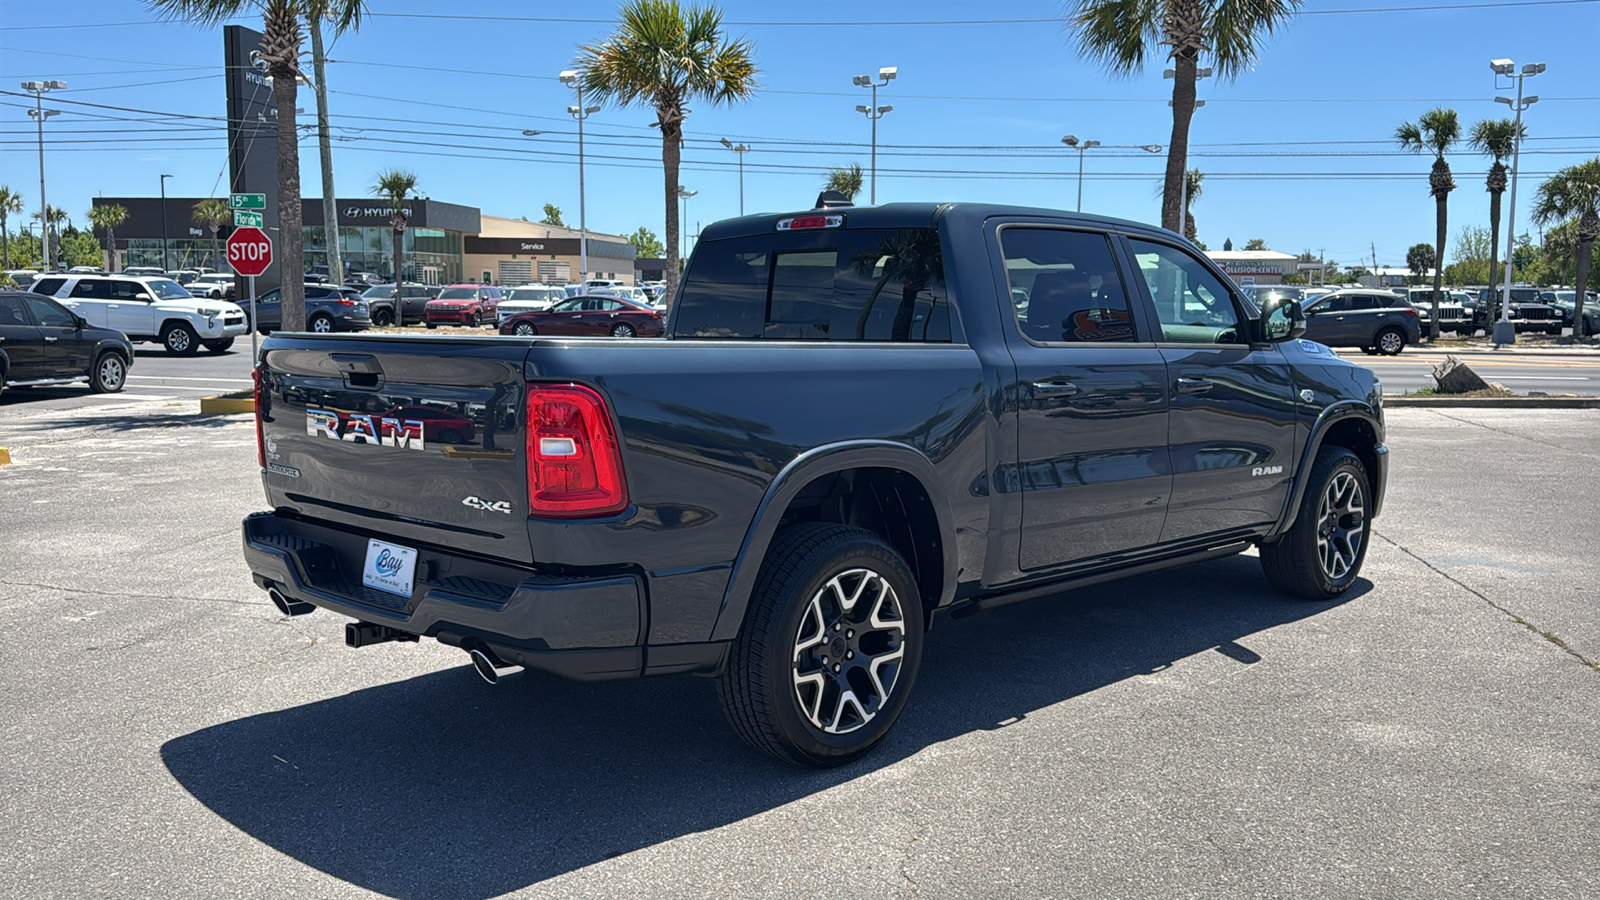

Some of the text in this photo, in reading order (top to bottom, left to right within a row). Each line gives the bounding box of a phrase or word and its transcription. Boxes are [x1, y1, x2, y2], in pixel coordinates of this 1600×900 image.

[231, 196, 249, 207] 15th
[235, 212, 256, 225] Florida
[189, 227, 203, 236] Bay
[230, 242, 269, 261] STOP
[521, 242, 544, 250] Service
[1258, 264, 1283, 273] CENTER
[307, 409, 425, 450] RAM
[1252, 465, 1283, 477] RAM
[378, 548, 403, 577] Bay
